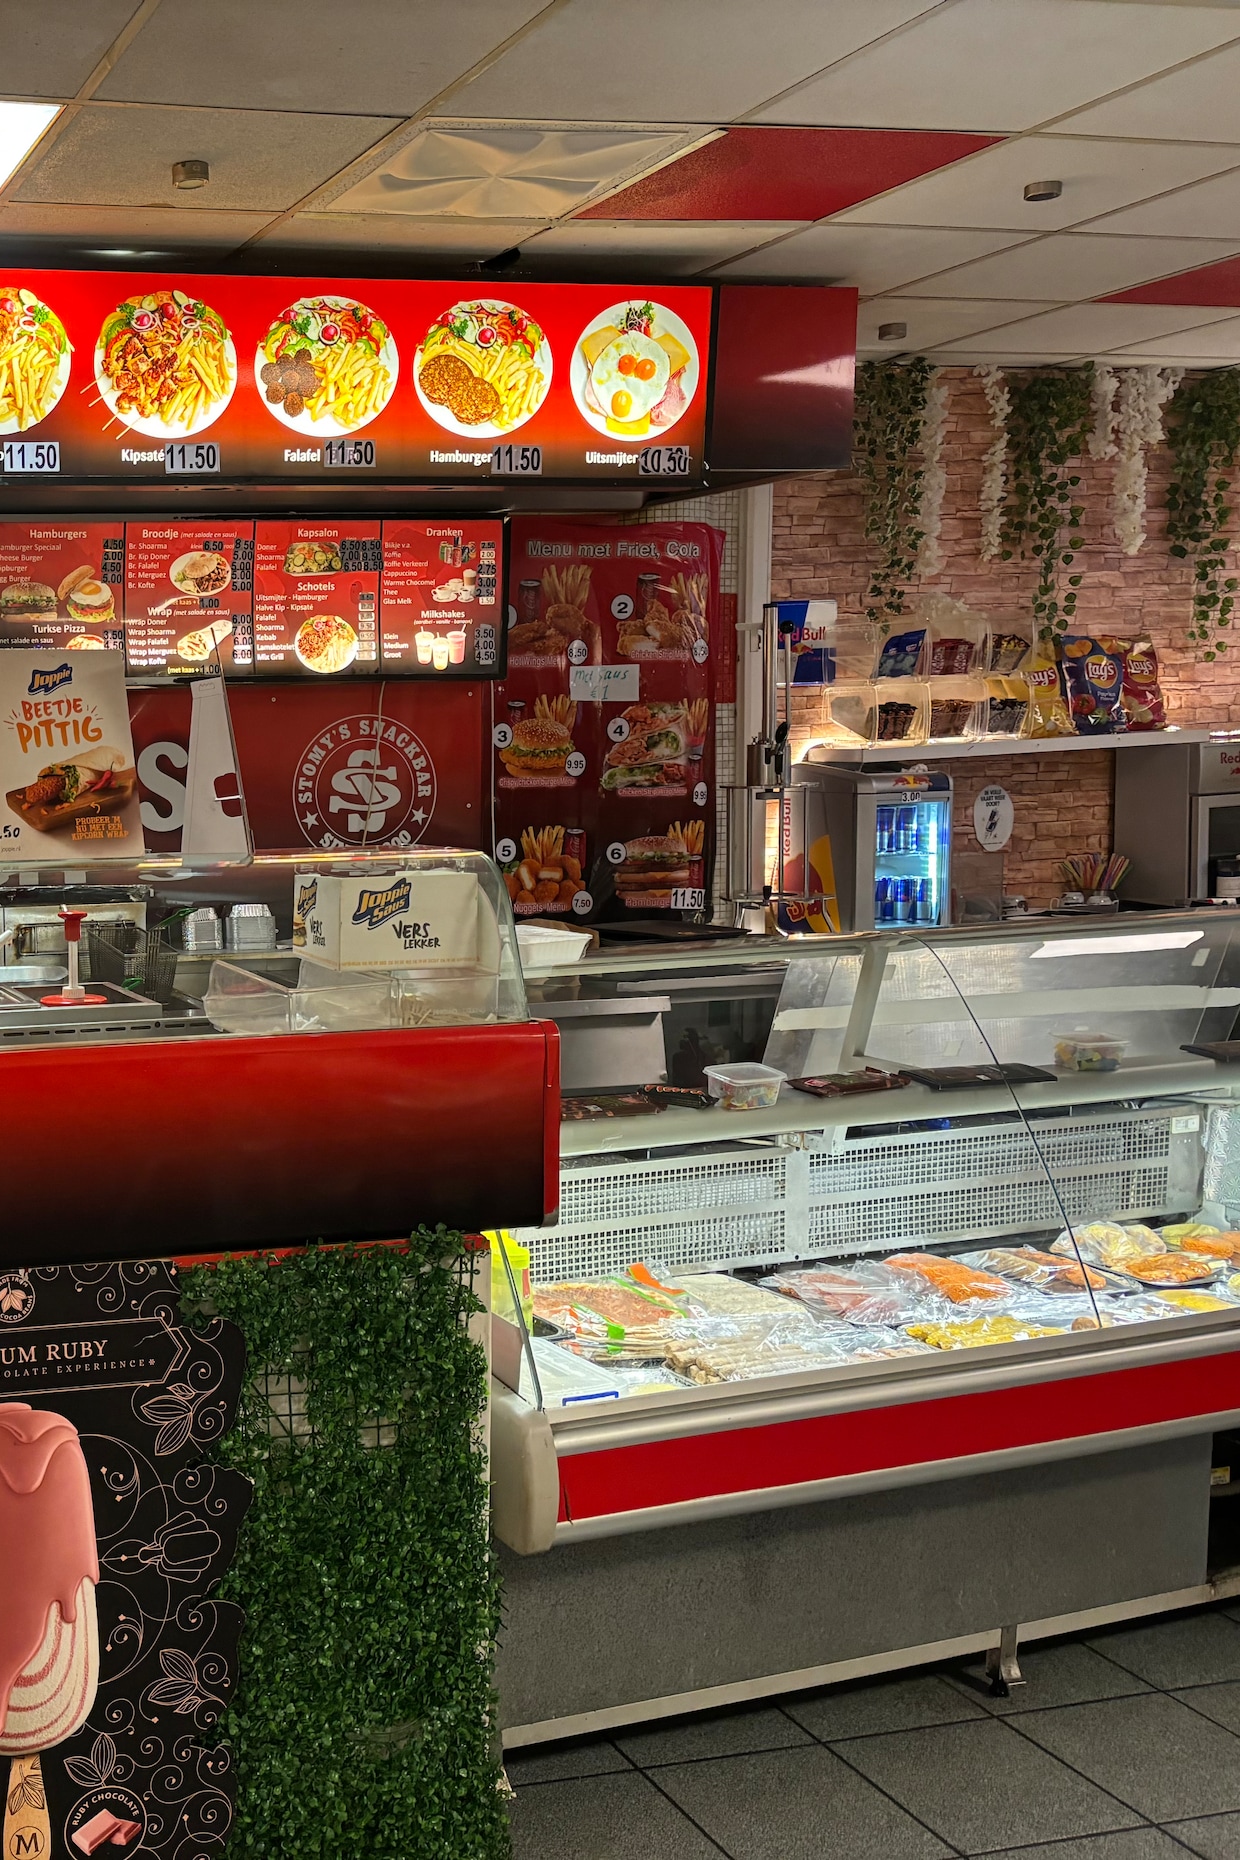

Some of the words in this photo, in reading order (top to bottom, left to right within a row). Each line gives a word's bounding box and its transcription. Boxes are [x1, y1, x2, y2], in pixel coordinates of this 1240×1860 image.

[6, 444, 57, 469] 11.50
[122, 448, 164, 464] Kipsaté
[167, 445, 216, 468] 11.50
[284, 450, 320, 462] Falafel
[326, 441, 373, 465] 11.50
[430, 451, 492, 466] Hamburger
[494, 445, 540, 471] 11.50
[586, 452, 638, 467] Uitsmijter
[30, 530, 87, 540] Hamburgers
[143, 530, 179, 539] Broodje
[298, 528, 338, 539] Kapsalon
[427, 528, 463, 536] Dranken
[35, 544, 61, 552] Speciaal
[528, 540, 572, 557] Menu
[578, 542, 610, 557] met
[617, 541, 660, 559] Friet,
[667, 541, 700, 557] Cola
[478, 564, 496, 574] 2.75
[298, 582, 335, 591] Schotels
[478, 579, 496, 587] 3.00
[147, 607, 172, 617] Wrap
[421, 610, 465, 618] Milkshakes
[617, 602, 628, 614] 2
[33, 625, 62, 633] Turkse
[64, 625, 85, 633] Pizza
[802, 627, 826, 640] Bull
[1088, 662, 1114, 681] Lay's
[1129, 658, 1153, 675] Lay's
[34, 668, 71, 689] Joppie
[21, 698, 82, 721] BEETJE
[16, 716, 102, 753] PITTIG
[498, 731, 507, 742] 3
[613, 725, 624, 736] 4
[298, 723, 351, 804] STOMY'S
[360, 720, 431, 797] SNACKBAR
[1221, 752, 1240, 763] Red
[567, 759, 584, 769] 9.95
[902, 793, 920, 801] 3.00
[75, 816, 109, 825] PROBEER
[90, 824, 106, 832] MET
[108, 823, 123, 831] EEN
[71, 832, 104, 840] KIPCORN
[106, 830, 129, 838] WRAP
[502, 845, 511, 856] 5
[611, 848, 620, 859] 6
[358, 883, 410, 914] Joppie
[574, 899, 590, 908] 7.50
[672, 890, 703, 908] 11.50
[372, 899, 406, 923] Saus
[392, 920, 430, 939] VERS
[404, 937, 440, 949] LEKKER
[46, 1340, 109, 1361] RUBY
[57, 1359, 145, 1374] EXPERIENCE
[72, 1801, 90, 1826] RUBY
[91, 1792, 140, 1817] CHOCOLATE
[16, 1833, 39, 1856] M
